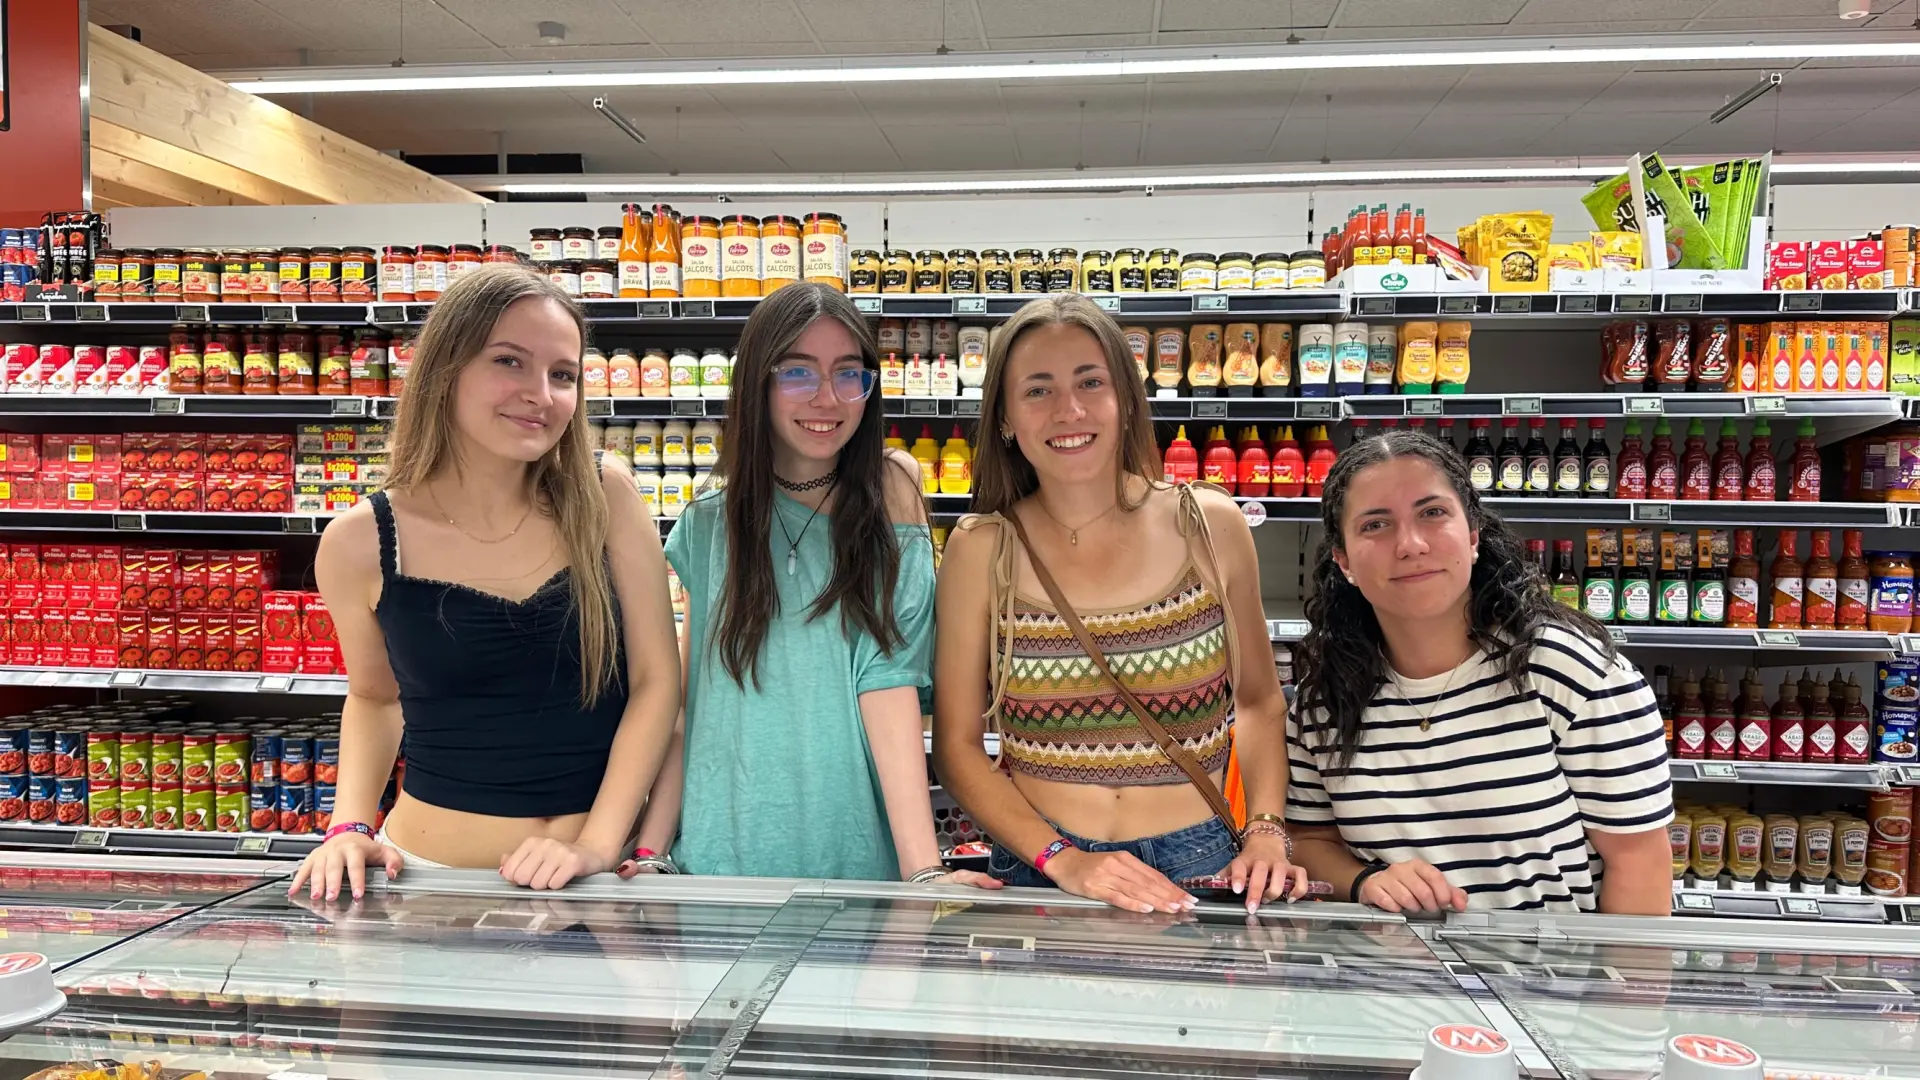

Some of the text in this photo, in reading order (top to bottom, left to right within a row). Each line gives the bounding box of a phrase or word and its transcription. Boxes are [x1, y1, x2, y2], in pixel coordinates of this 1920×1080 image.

[327, 432, 354, 443] 3x200g
[327, 462, 355, 473] 3x200g
[327, 491, 356, 503] 3x200g
[265, 602, 296, 611] Orlando
[305, 602, 328, 611] Orlan
